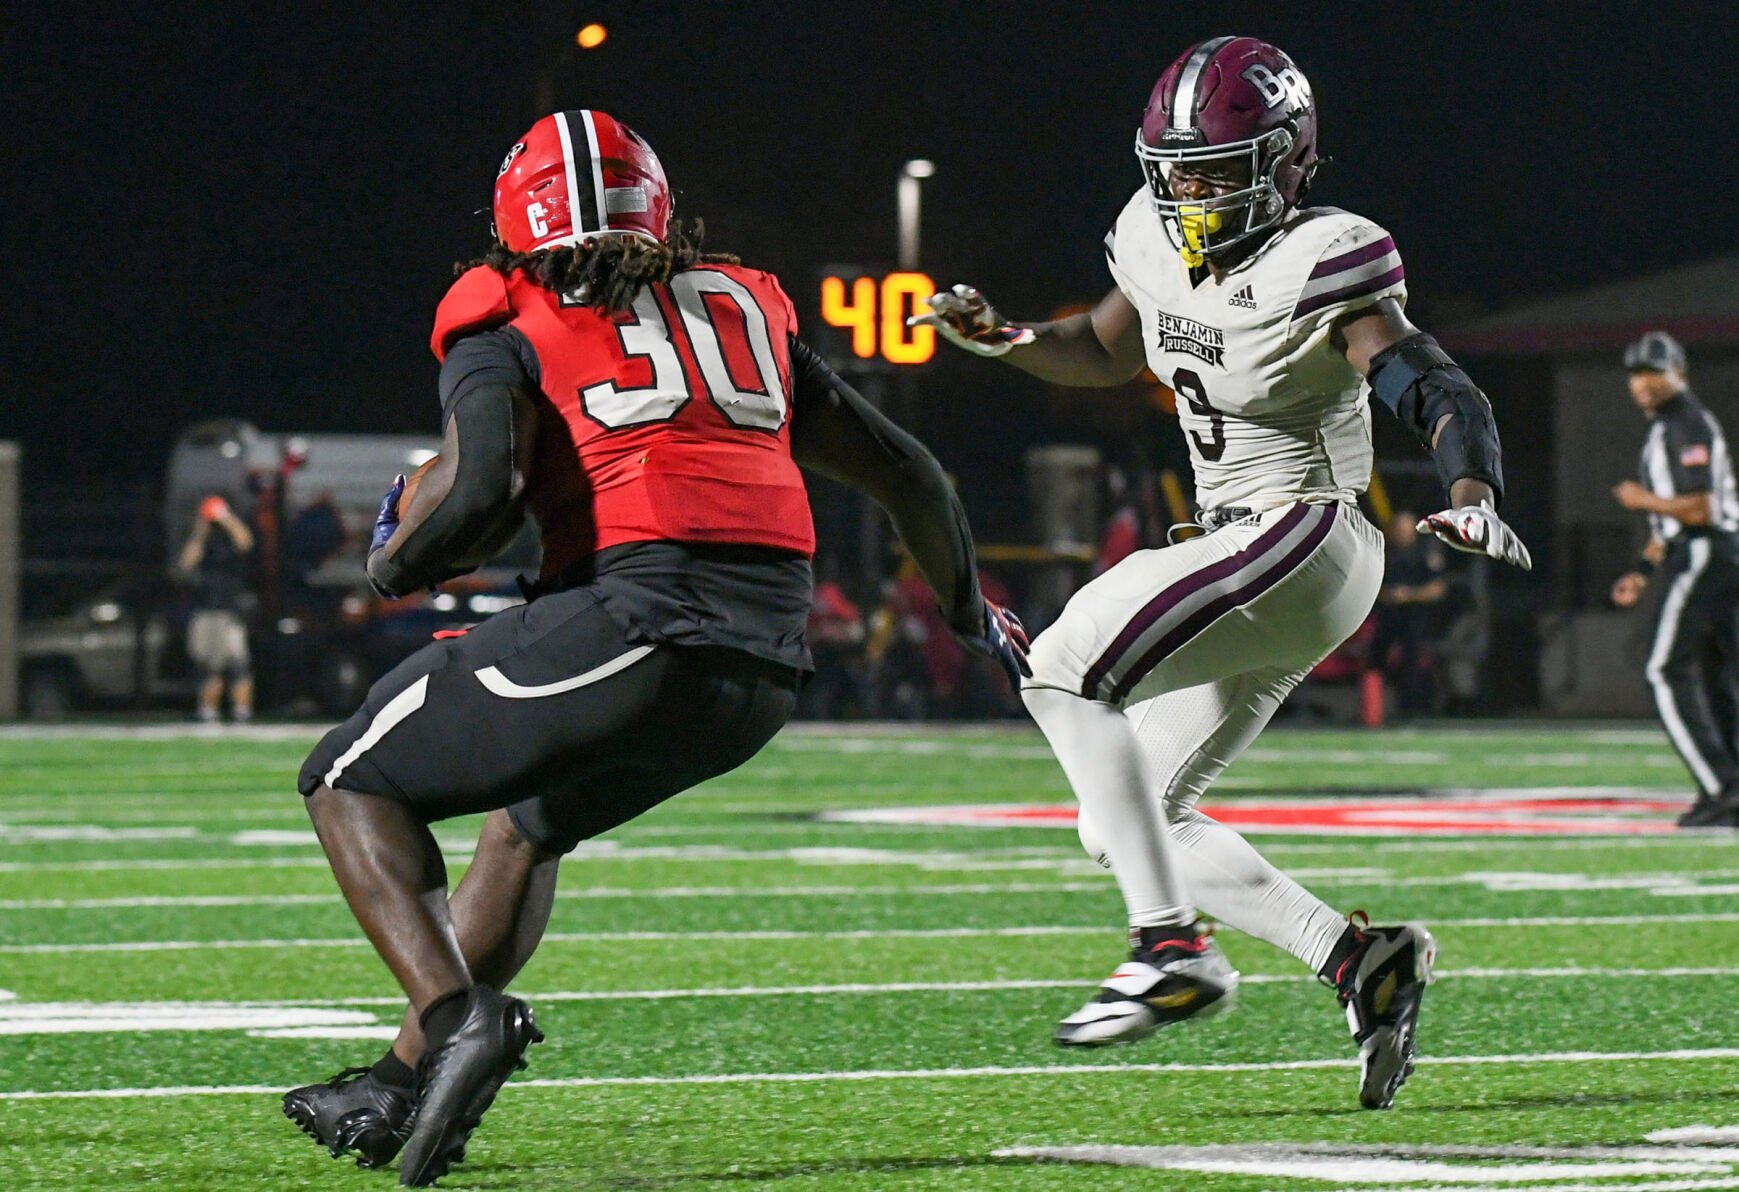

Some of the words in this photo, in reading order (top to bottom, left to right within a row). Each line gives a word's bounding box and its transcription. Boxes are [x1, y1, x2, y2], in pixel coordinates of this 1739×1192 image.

[1241, 64, 1311, 112] BR
[821, 272, 936, 364] 40
[1228, 298, 1257, 309] adidas
[562, 269, 785, 430] 30
[1158, 312, 1225, 346] BENJAMIN
[1166, 337, 1214, 363] RUSSELL
[1172, 367, 1226, 462] 9
